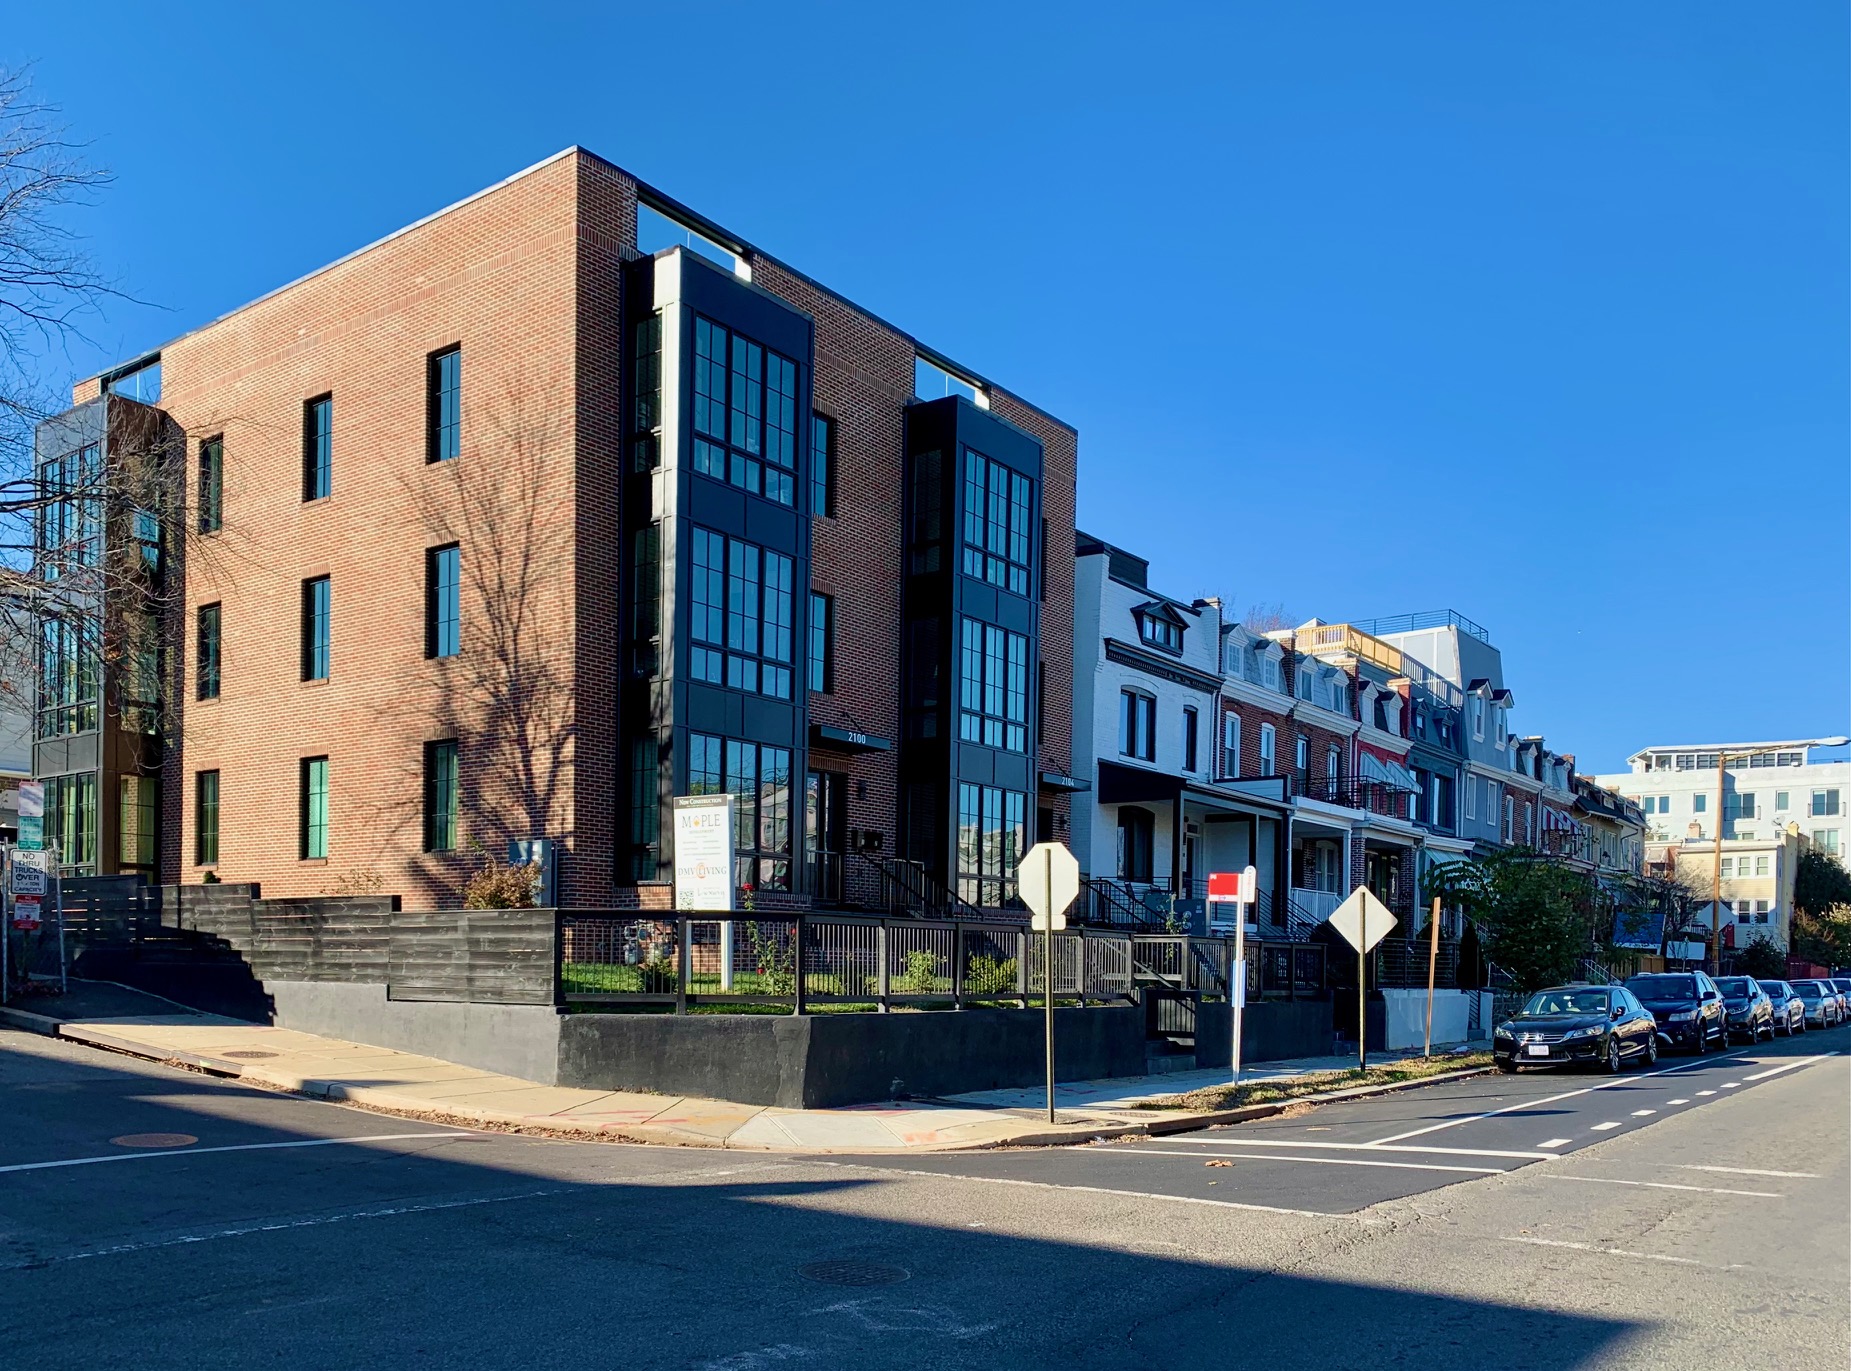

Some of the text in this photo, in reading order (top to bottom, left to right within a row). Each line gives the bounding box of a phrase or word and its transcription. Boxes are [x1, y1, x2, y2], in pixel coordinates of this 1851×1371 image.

[848, 731, 866, 744] 2100
[1061, 776, 1075, 787] 2104
[682, 814, 721, 828] MAPLE
[14, 866, 43, 874] TRUCKS
